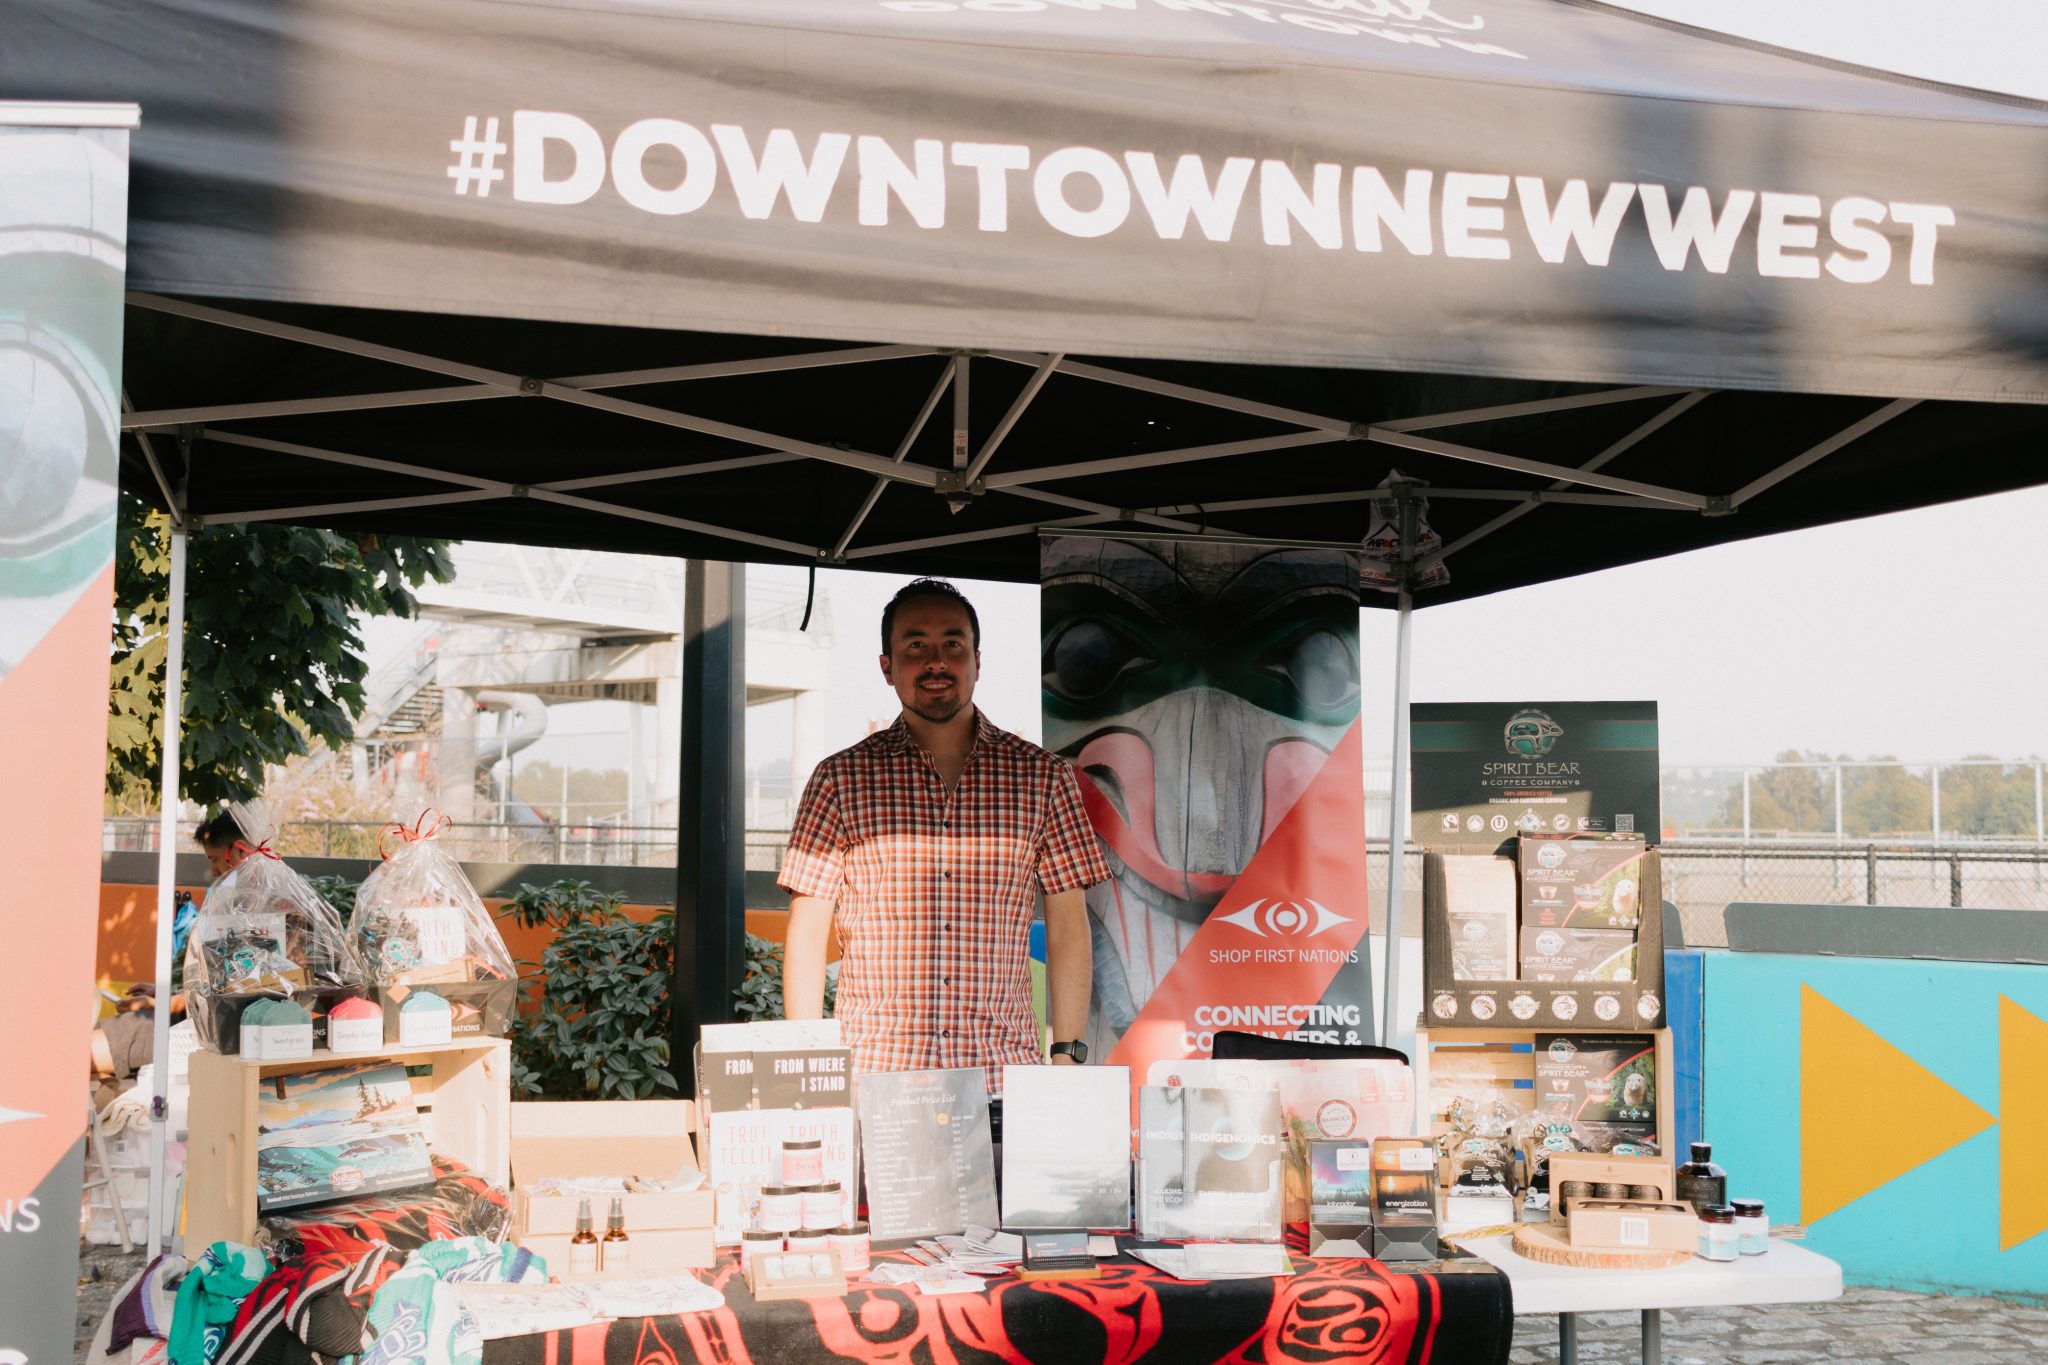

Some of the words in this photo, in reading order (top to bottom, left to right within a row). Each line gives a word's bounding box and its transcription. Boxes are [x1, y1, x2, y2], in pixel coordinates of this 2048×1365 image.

[446, 109, 1956, 285] #DOWNTOWNNEWWEST
[1482, 762, 1532, 775] SPIRIT
[1536, 762, 1581, 775] BEAR
[1209, 949, 1250, 963] SHOP
[1255, 949, 1295, 963] FIRST
[1299, 949, 1359, 963] NATIONS
[1194, 1004, 1361, 1027] CONNECTING
[1179, 1030, 1341, 1053] COERS
[774, 1058, 804, 1075] FROM
[808, 1057, 846, 1073] WHERE
[801, 1077, 806, 1092] I
[809, 1076, 845, 1092] STAND
[941, 1093, 956, 1102] List
[728, 1125, 768, 1145] TRUT
[1190, 1133, 1276, 1145] INDIGENOMICS
[1385, 1200, 1428, 1208] energization
